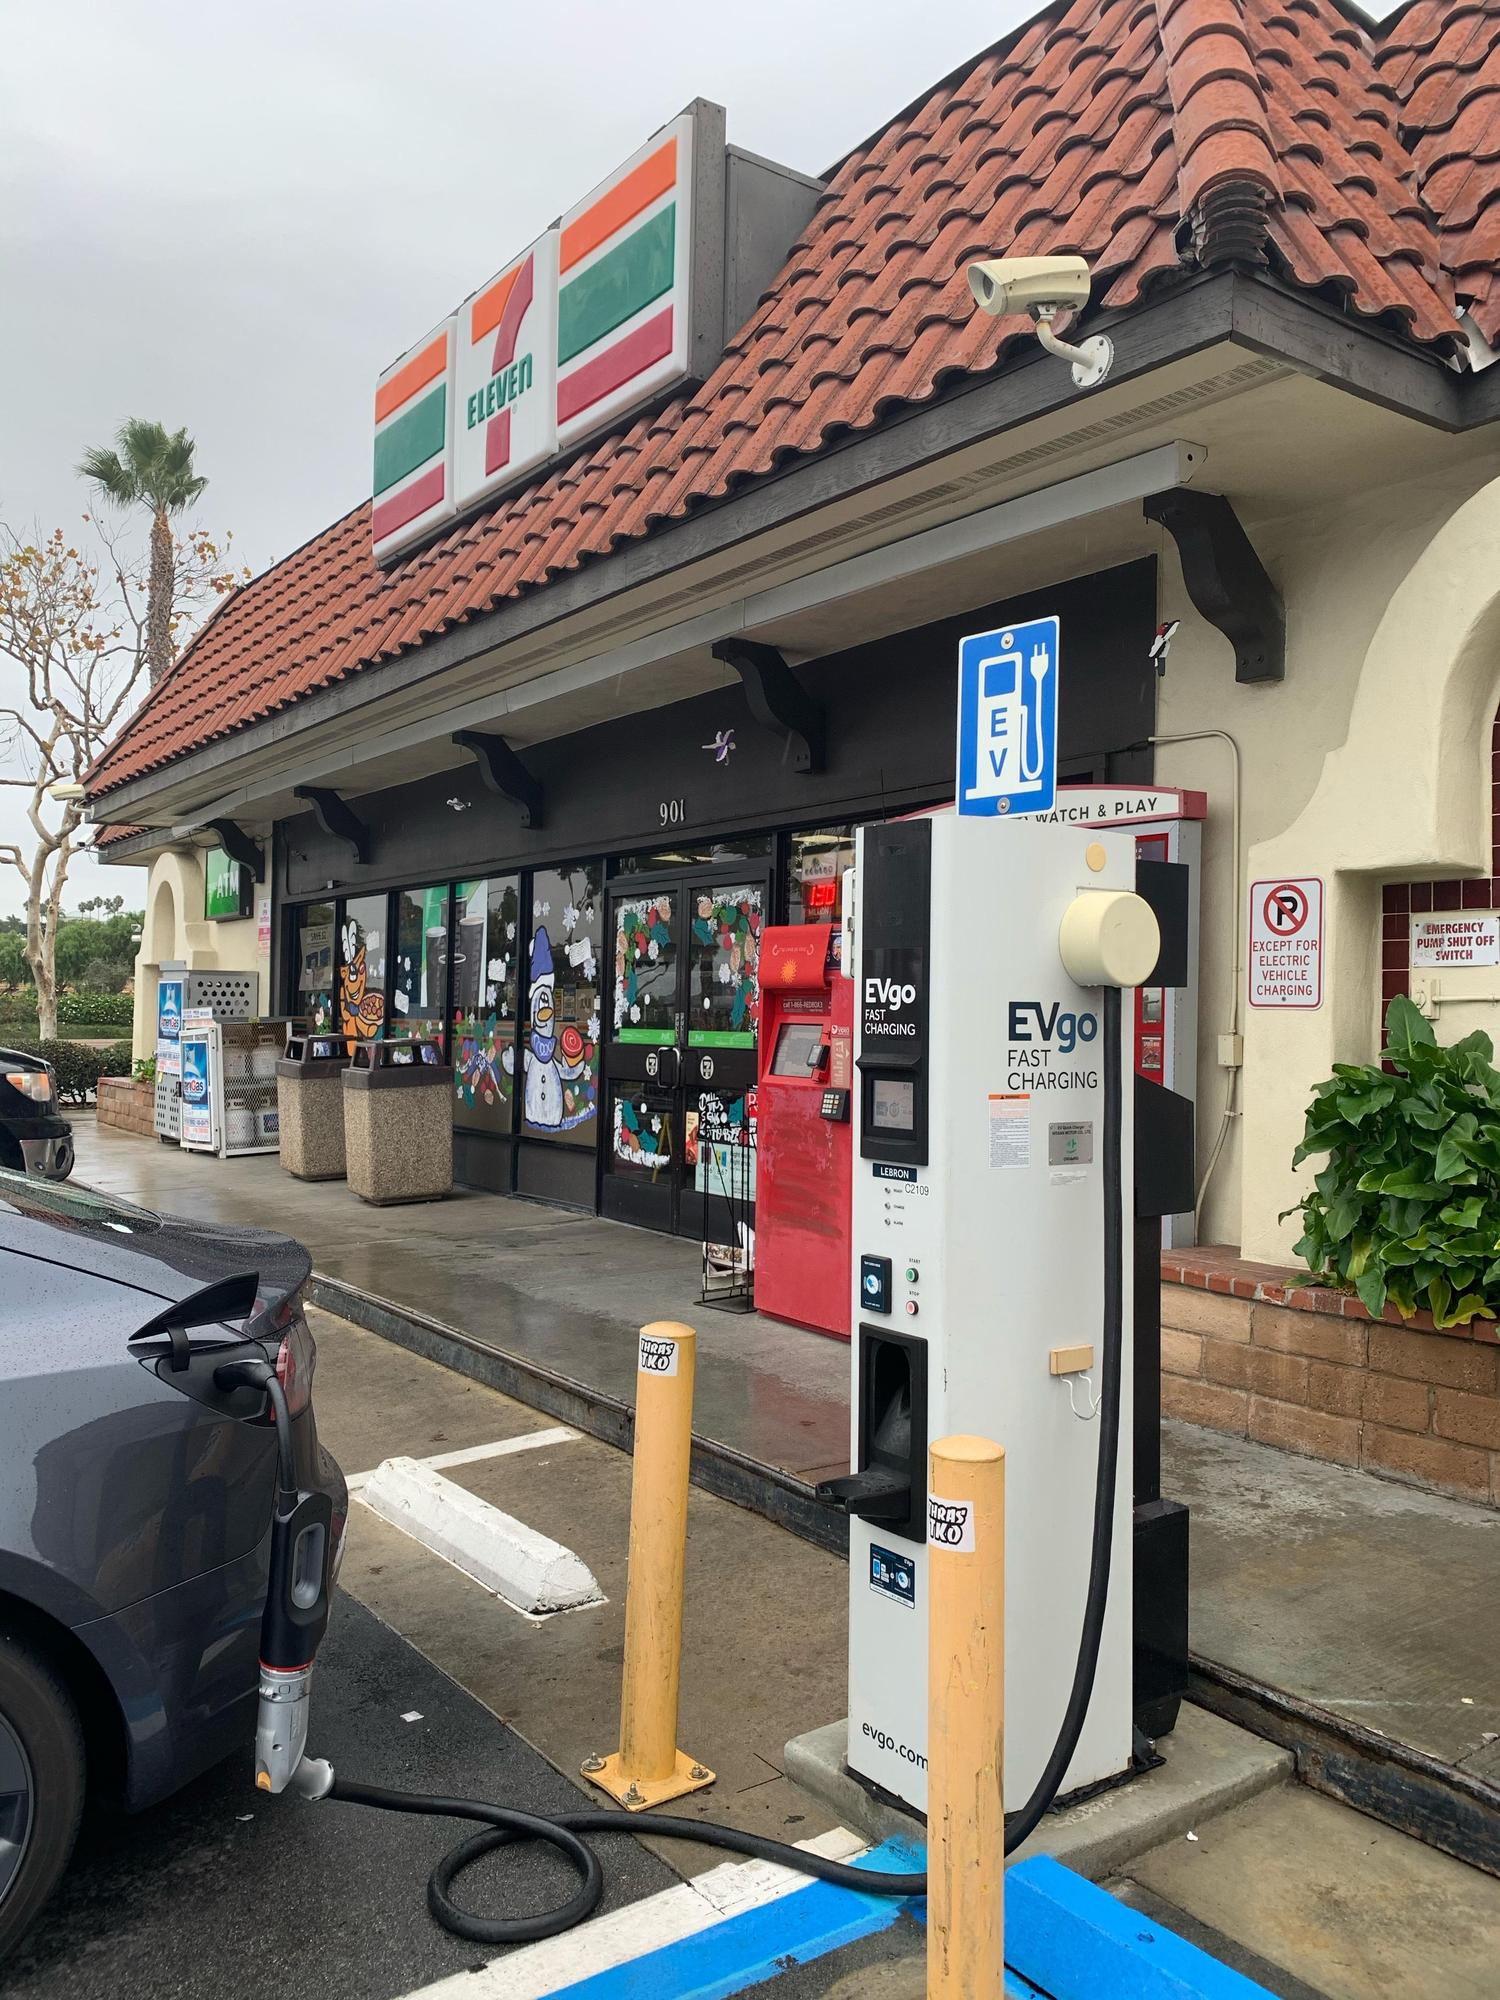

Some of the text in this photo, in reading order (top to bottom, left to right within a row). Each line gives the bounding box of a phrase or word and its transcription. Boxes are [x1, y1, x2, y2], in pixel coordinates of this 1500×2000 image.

[471, 250, 534, 478] 7
[659, 798, 685, 827] 901
[1036, 797, 1158, 824] WATCH & PLAY
[216, 869, 240, 899] ATM
[1425, 921, 1485, 935] EMERGENCY
[1252, 939, 1319, 953] EXCEPT FOR
[1416, 935, 1495, 949] PUMP SHUT OFF
[1259, 954, 1311, 967] ELECTRIC
[1435, 949, 1473, 961] SWITCH
[1261, 969, 1308, 981] VEHICLE
[865, 977, 917, 1011] EVgo
[1256, 984, 1313, 996] CHARGING
[864, 1009, 887, 1021] FAST
[864, 1023, 916, 1036] CHARGING
[1008, 1001, 1098, 1054] EVgo
[1007, 1049, 1052, 1068] FAST
[1007, 1071, 1098, 1091] CHARGING
[880, 1166, 910, 1179] LEBRON
[904, 1183, 929, 1196] C2109
[642, 1354, 670, 1371] TKO
[929, 1518, 963, 1546] TKO
[861, 1722, 929, 1773] evgo.com
